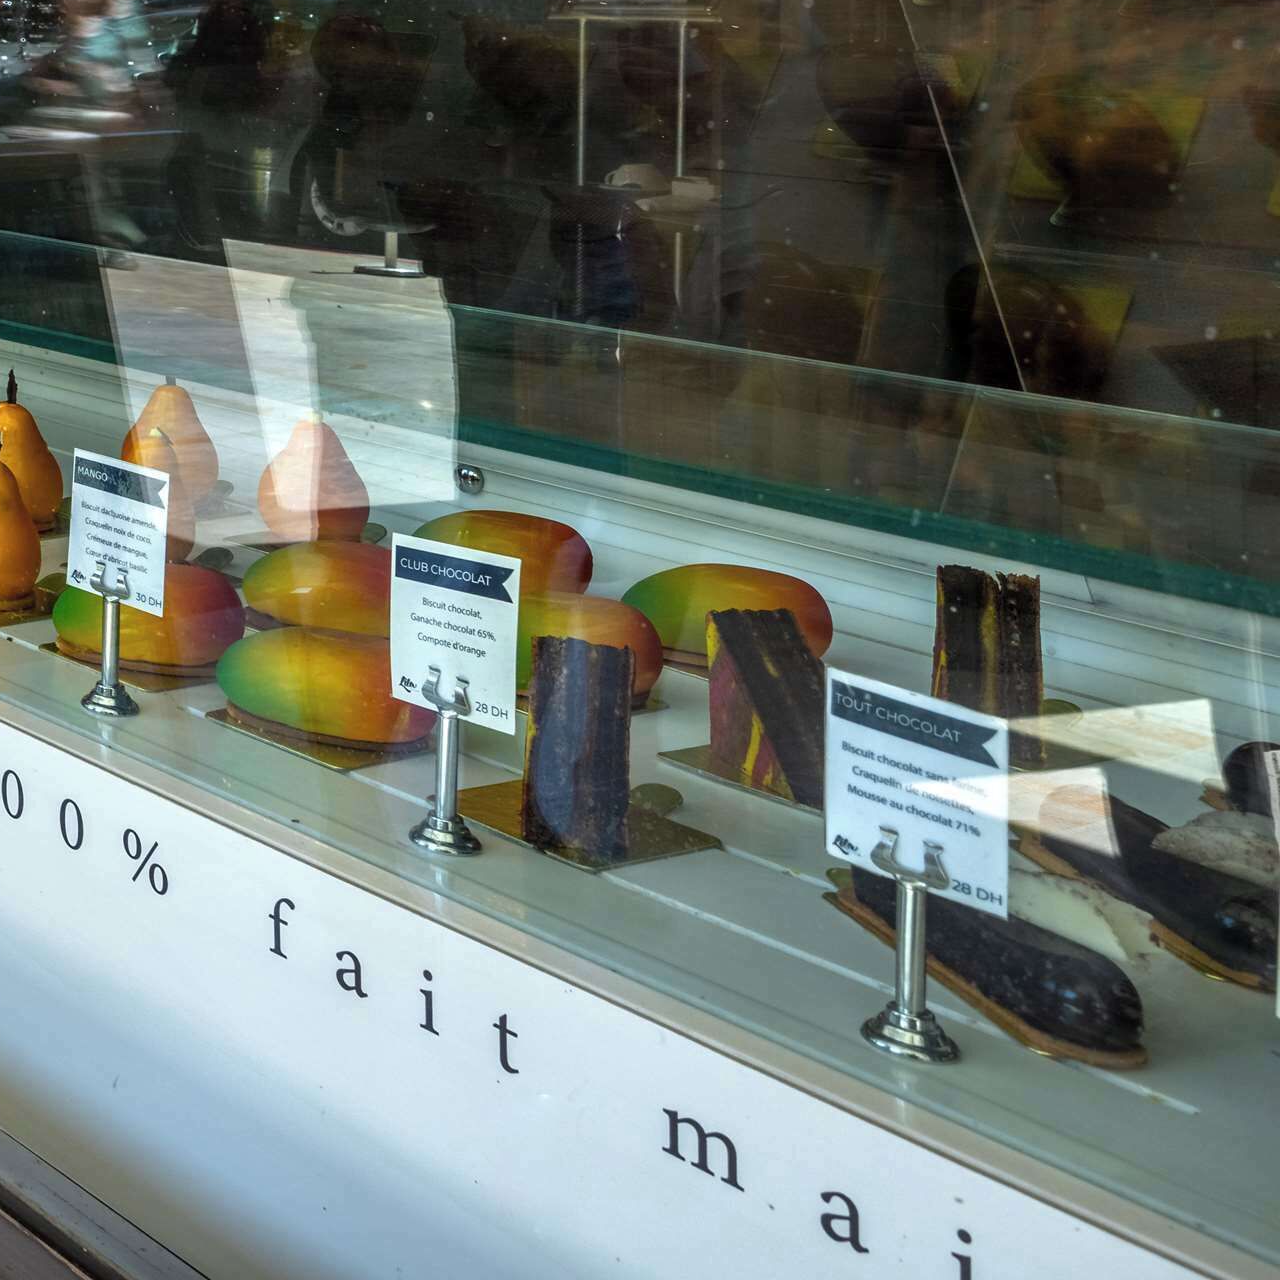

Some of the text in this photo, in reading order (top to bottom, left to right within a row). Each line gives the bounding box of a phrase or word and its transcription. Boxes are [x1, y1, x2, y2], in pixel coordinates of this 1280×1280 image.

[78, 465, 108, 482] MANGO
[81, 500, 101, 514] Biscuit
[84, 517, 112, 532] Craquelin
[113, 526, 127, 536] noix
[400, 557, 493, 587] CLUB CHOCOLAT
[135, 592, 147, 604] 30
[148, 594, 162, 609] DH
[422, 597, 483, 620] Biscuit chocolat,
[410, 612, 497, 642] Ganache chocolat 65%,
[417, 632, 487, 658] Compote d'orange
[399, 675, 509, 720] Lila 28 DH
[834, 692, 962, 743] TOUT CHOCOLAT
[841, 741, 876, 761] Biscuit
[876, 753, 923, 778] chocolat
[925, 770, 950, 784] sans
[851, 766, 903, 790] Craquelin
[847, 784, 982, 837] Mousse au chocolat 71%
[951, 879, 972, 896] 28
[975, 887, 1003, 907] DH
[268, 896, 520, 1076] fait
